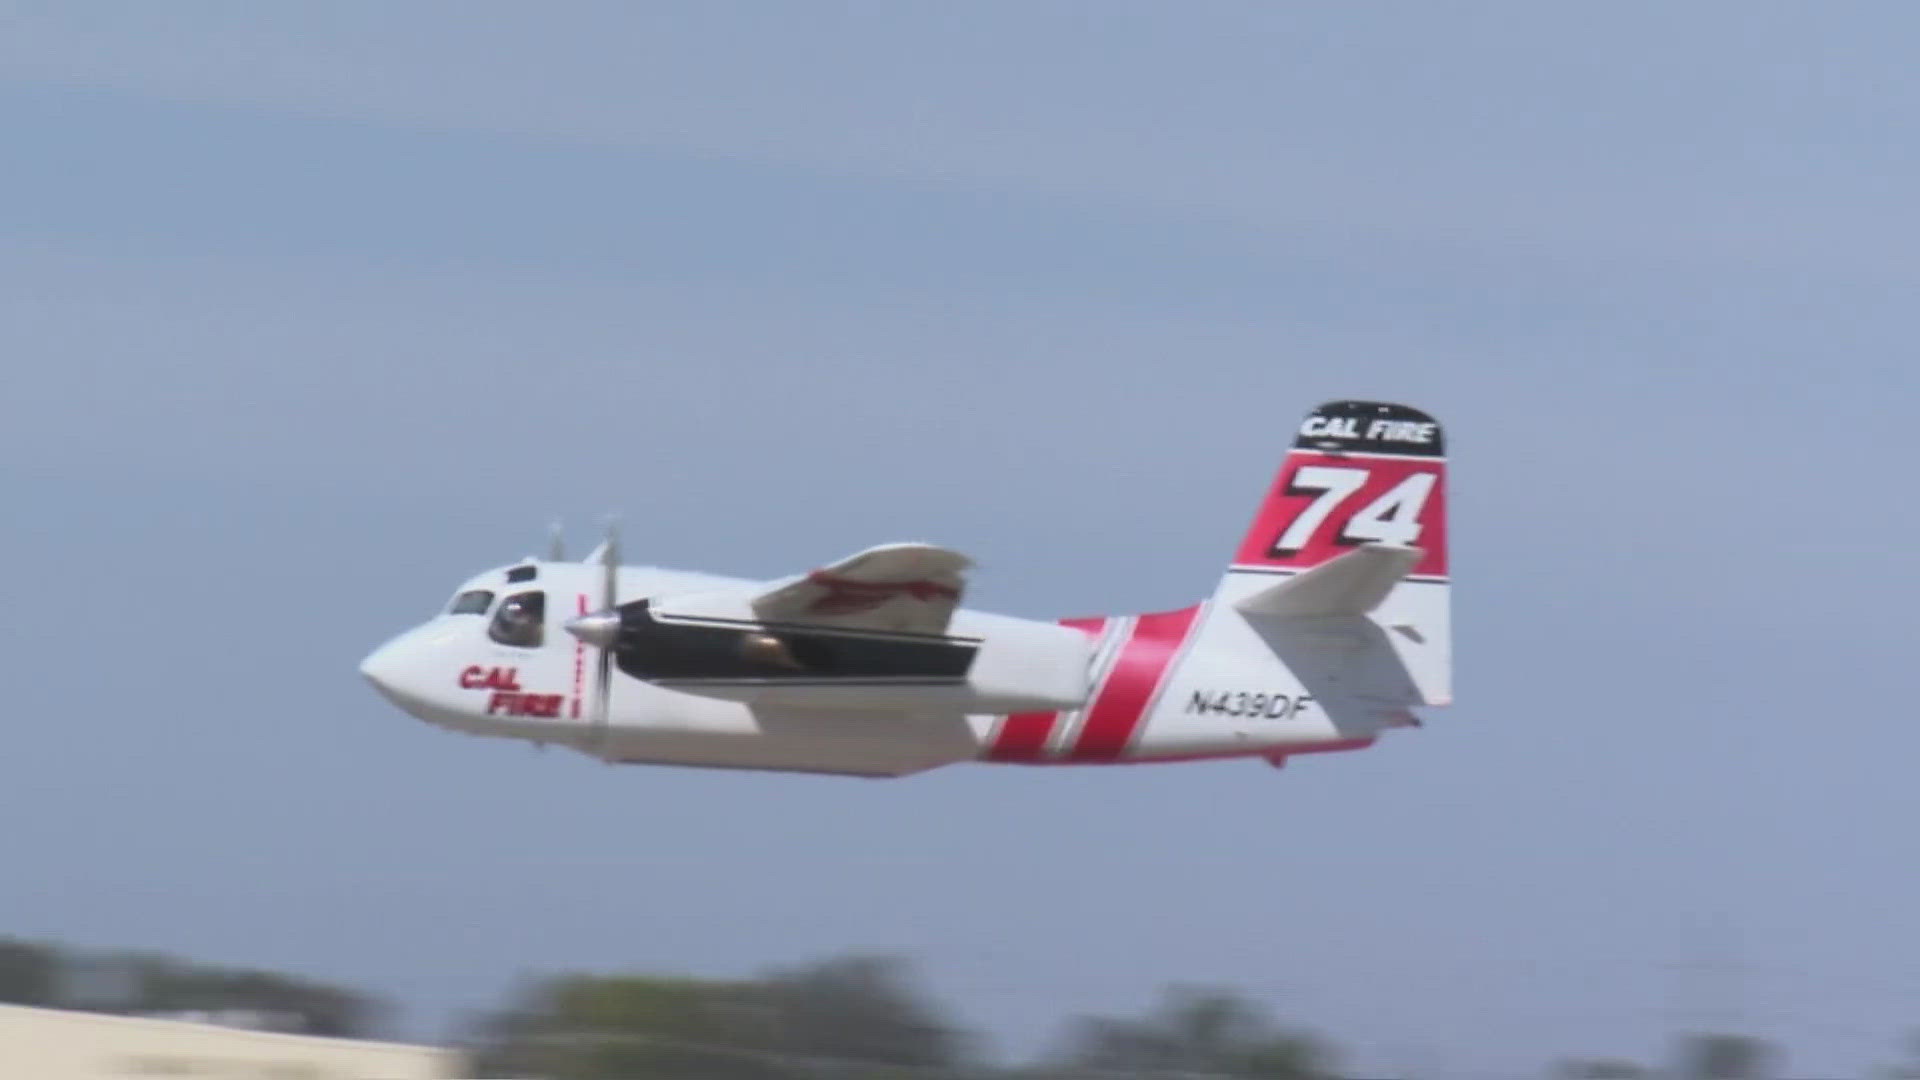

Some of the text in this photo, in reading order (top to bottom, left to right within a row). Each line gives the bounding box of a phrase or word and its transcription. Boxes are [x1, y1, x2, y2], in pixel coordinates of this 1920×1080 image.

[1301, 416, 1435, 443] CAL FIRE
[1269, 465, 1438, 551] 74
[459, 665, 521, 690] CAL
[488, 692, 565, 718] FIRE
[1186, 691, 1313, 720] N439DF
